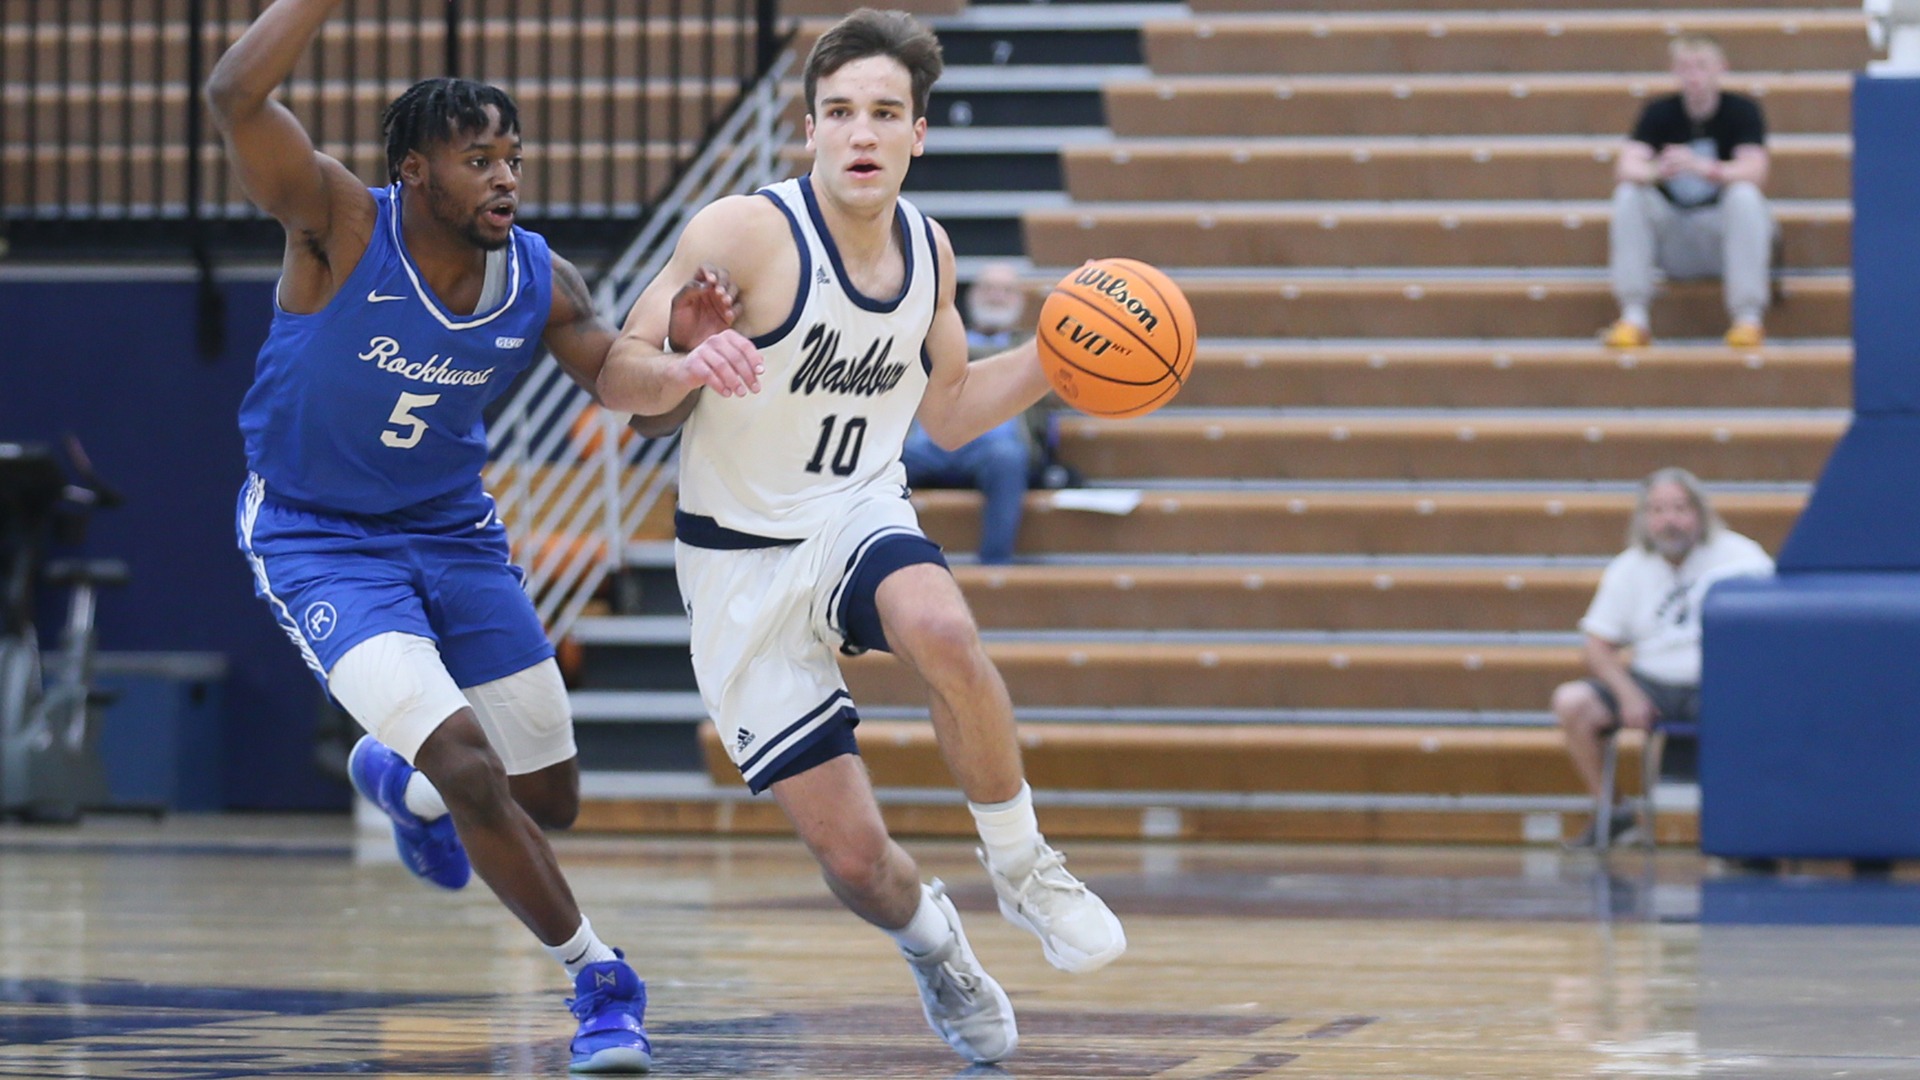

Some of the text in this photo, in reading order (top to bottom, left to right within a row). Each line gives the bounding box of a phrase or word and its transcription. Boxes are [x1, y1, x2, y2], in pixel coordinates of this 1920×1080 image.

[1074, 267, 1158, 333] Wilson
[358, 336, 496, 386] Rockhurst
[1055, 315, 1112, 356] EVO
[380, 391, 441, 449] 5
[804, 414, 867, 477] 10
